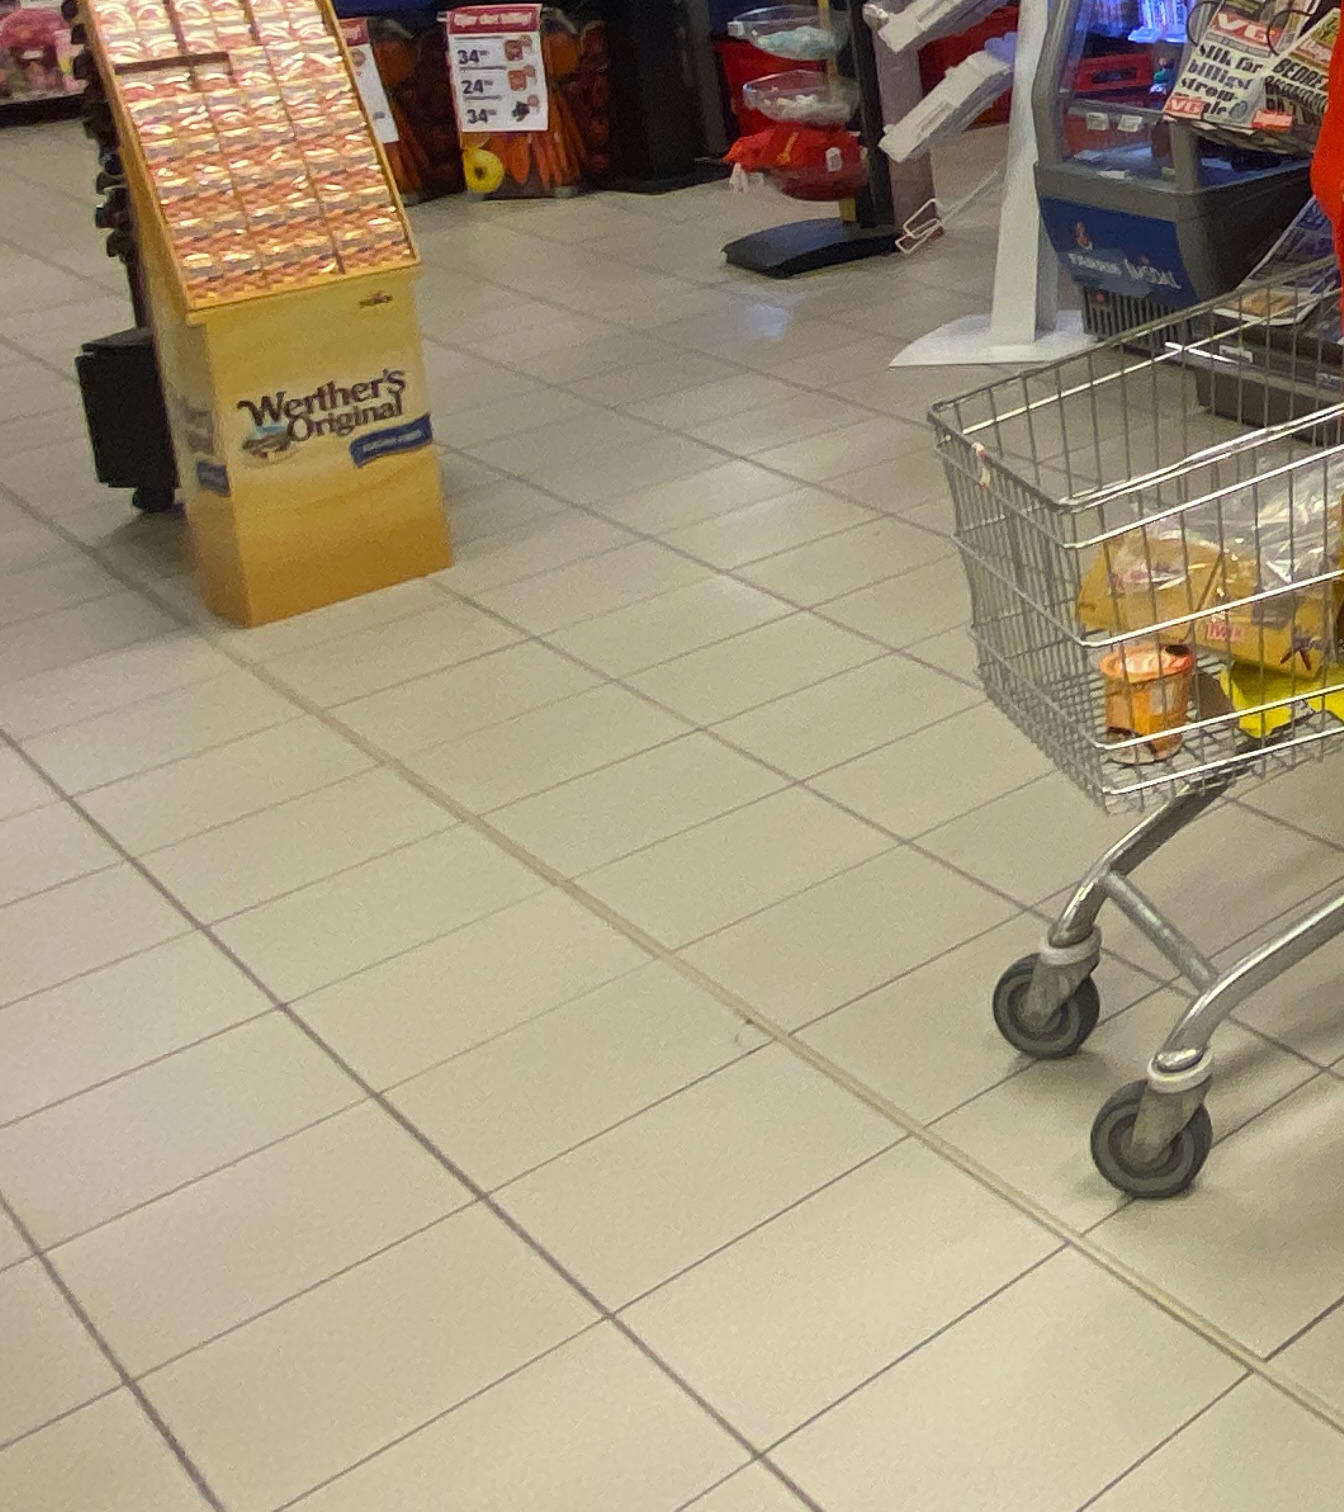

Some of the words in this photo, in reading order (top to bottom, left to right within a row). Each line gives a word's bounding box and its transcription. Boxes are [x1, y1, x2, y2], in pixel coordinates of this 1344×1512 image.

[457, 49, 480, 65] 34
[461, 79, 485, 95] 24
[467, 108, 489, 124] 34
[236, 368, 408, 427] Werther's
[287, 393, 404, 443] Original
